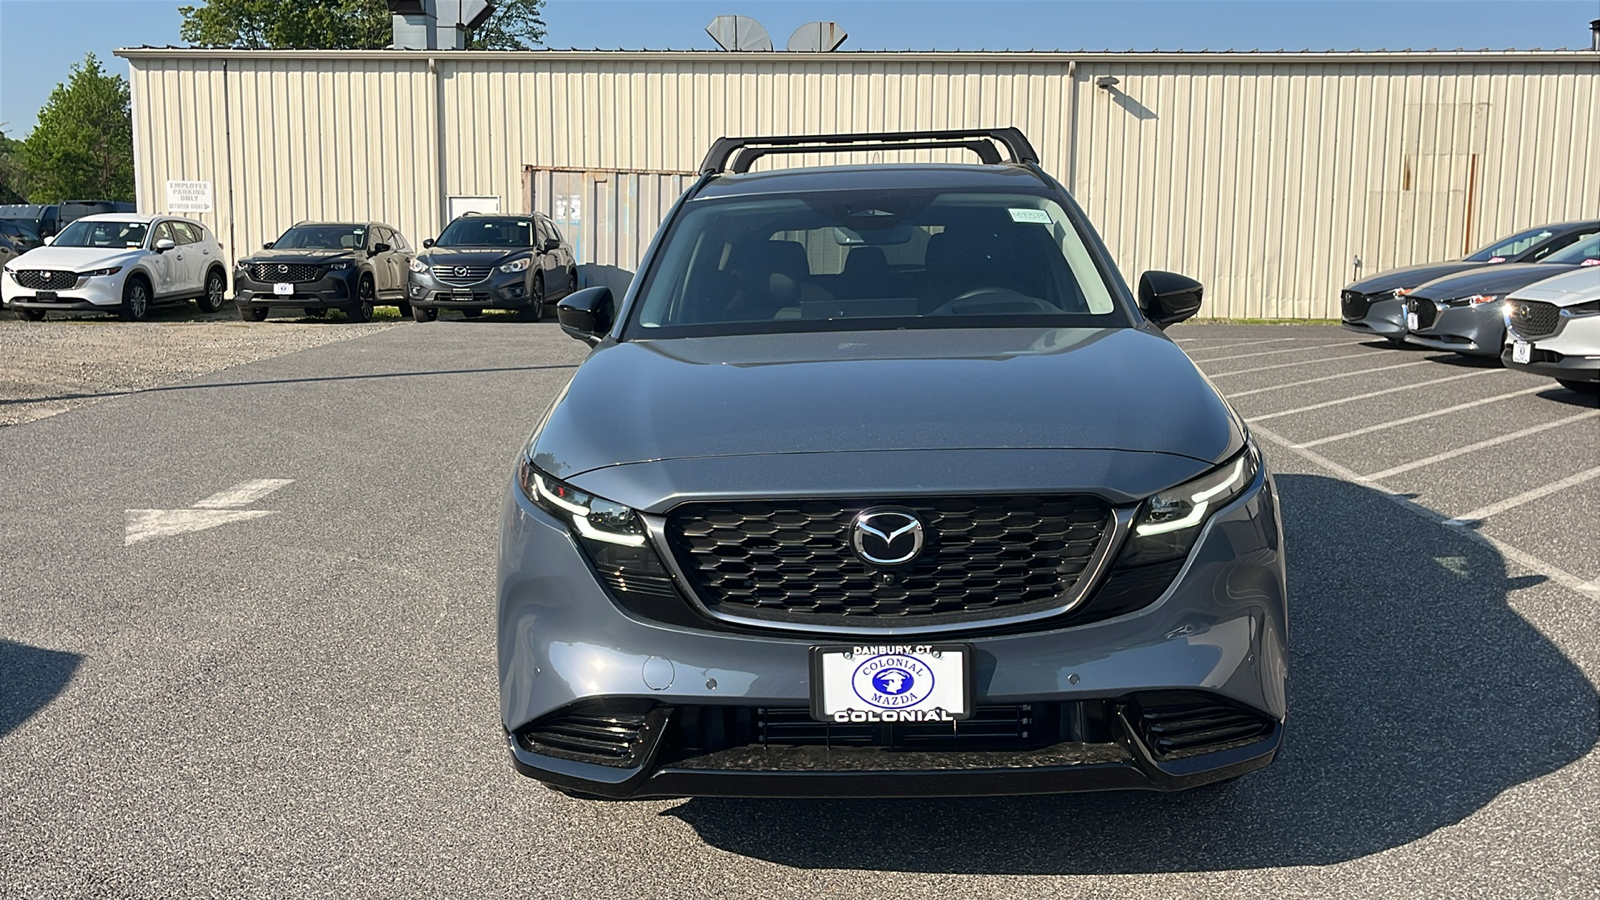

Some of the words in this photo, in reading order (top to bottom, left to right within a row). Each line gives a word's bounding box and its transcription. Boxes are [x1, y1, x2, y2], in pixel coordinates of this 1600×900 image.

[915, 645, 932, 654] CT
[862, 657, 924, 677] COLONIAL
[870, 692, 918, 706] MAZDA
[834, 710, 954, 722] COLONIAL
